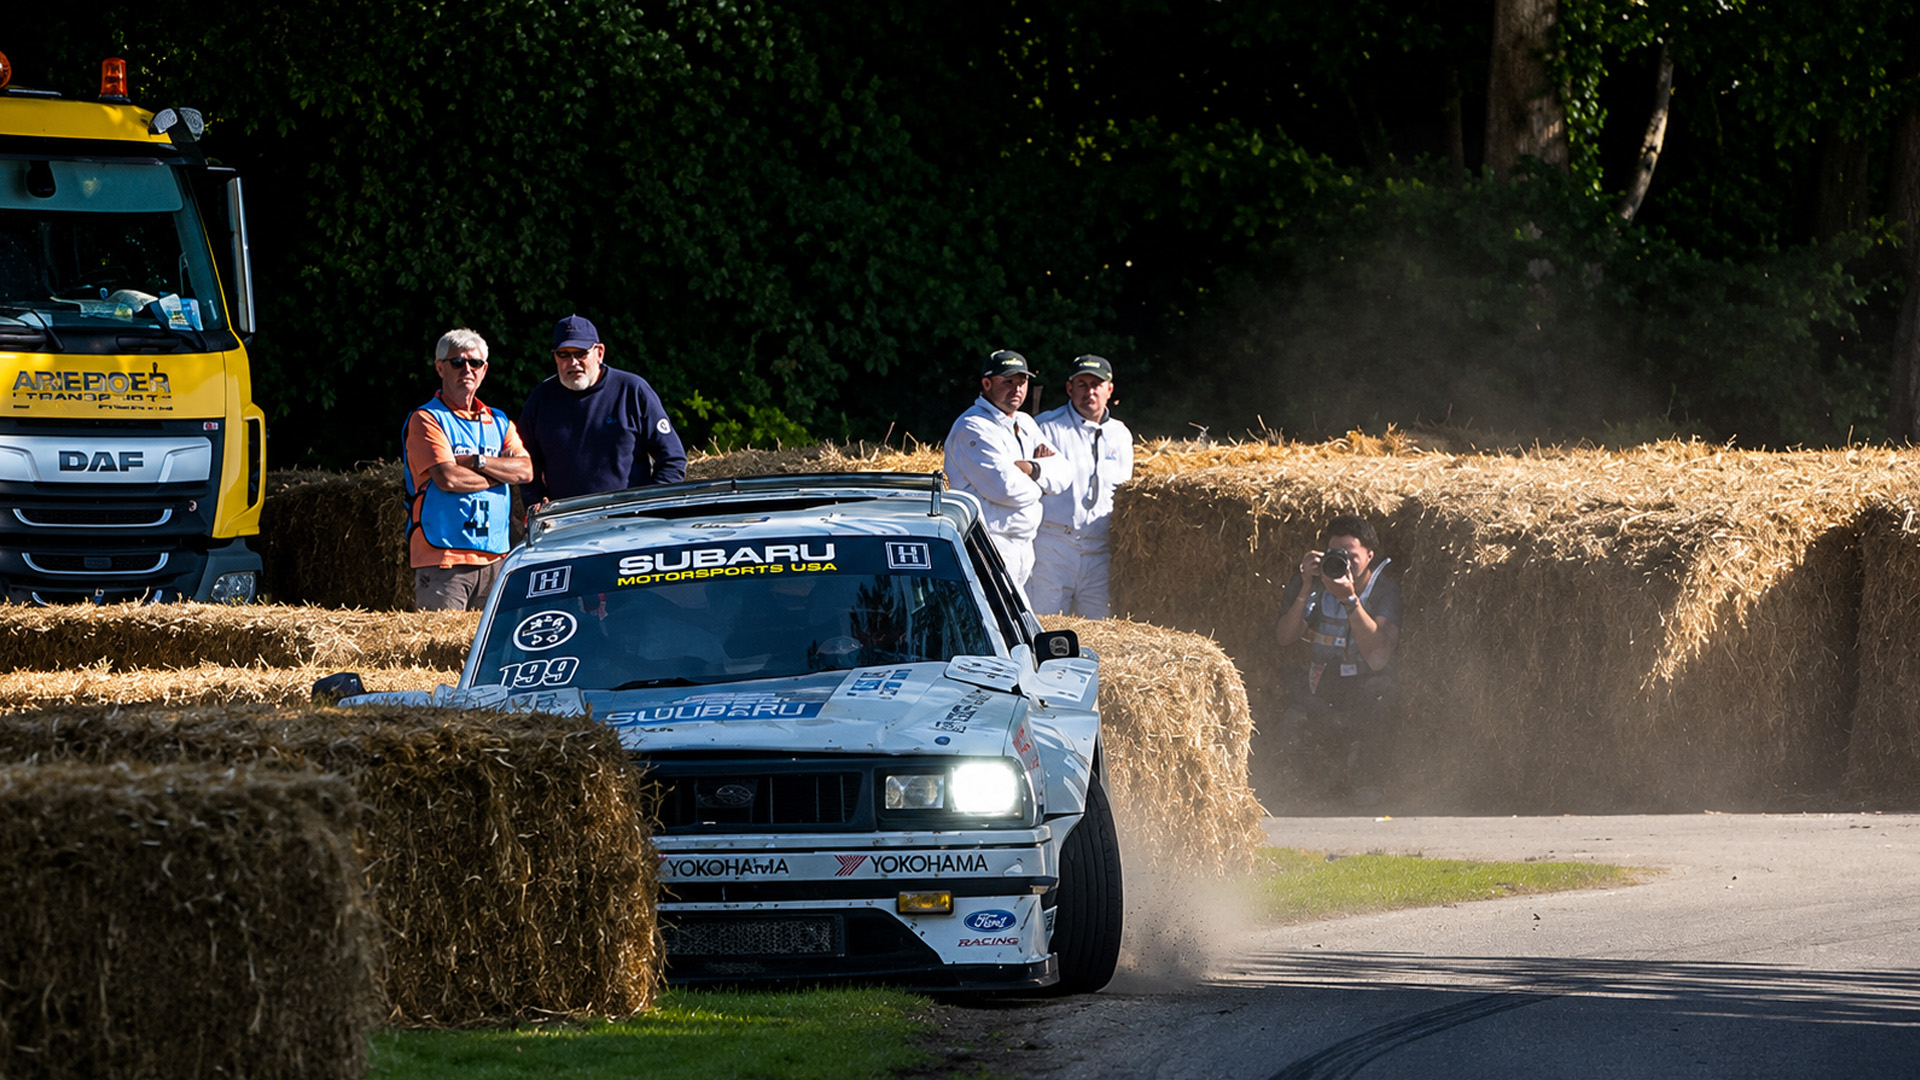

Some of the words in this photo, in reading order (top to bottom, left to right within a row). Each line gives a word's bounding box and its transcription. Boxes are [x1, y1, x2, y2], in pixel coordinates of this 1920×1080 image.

[58, 450, 144, 472] DAF
[618, 543, 836, 576] SUBARU
[617, 564, 784, 586] MOTORSPORTS
[791, 562, 838, 573] USA
[499, 656, 580, 690] 199
[870, 854, 989, 874] YOKOHAMA
[957, 937, 1019, 947] RACING
